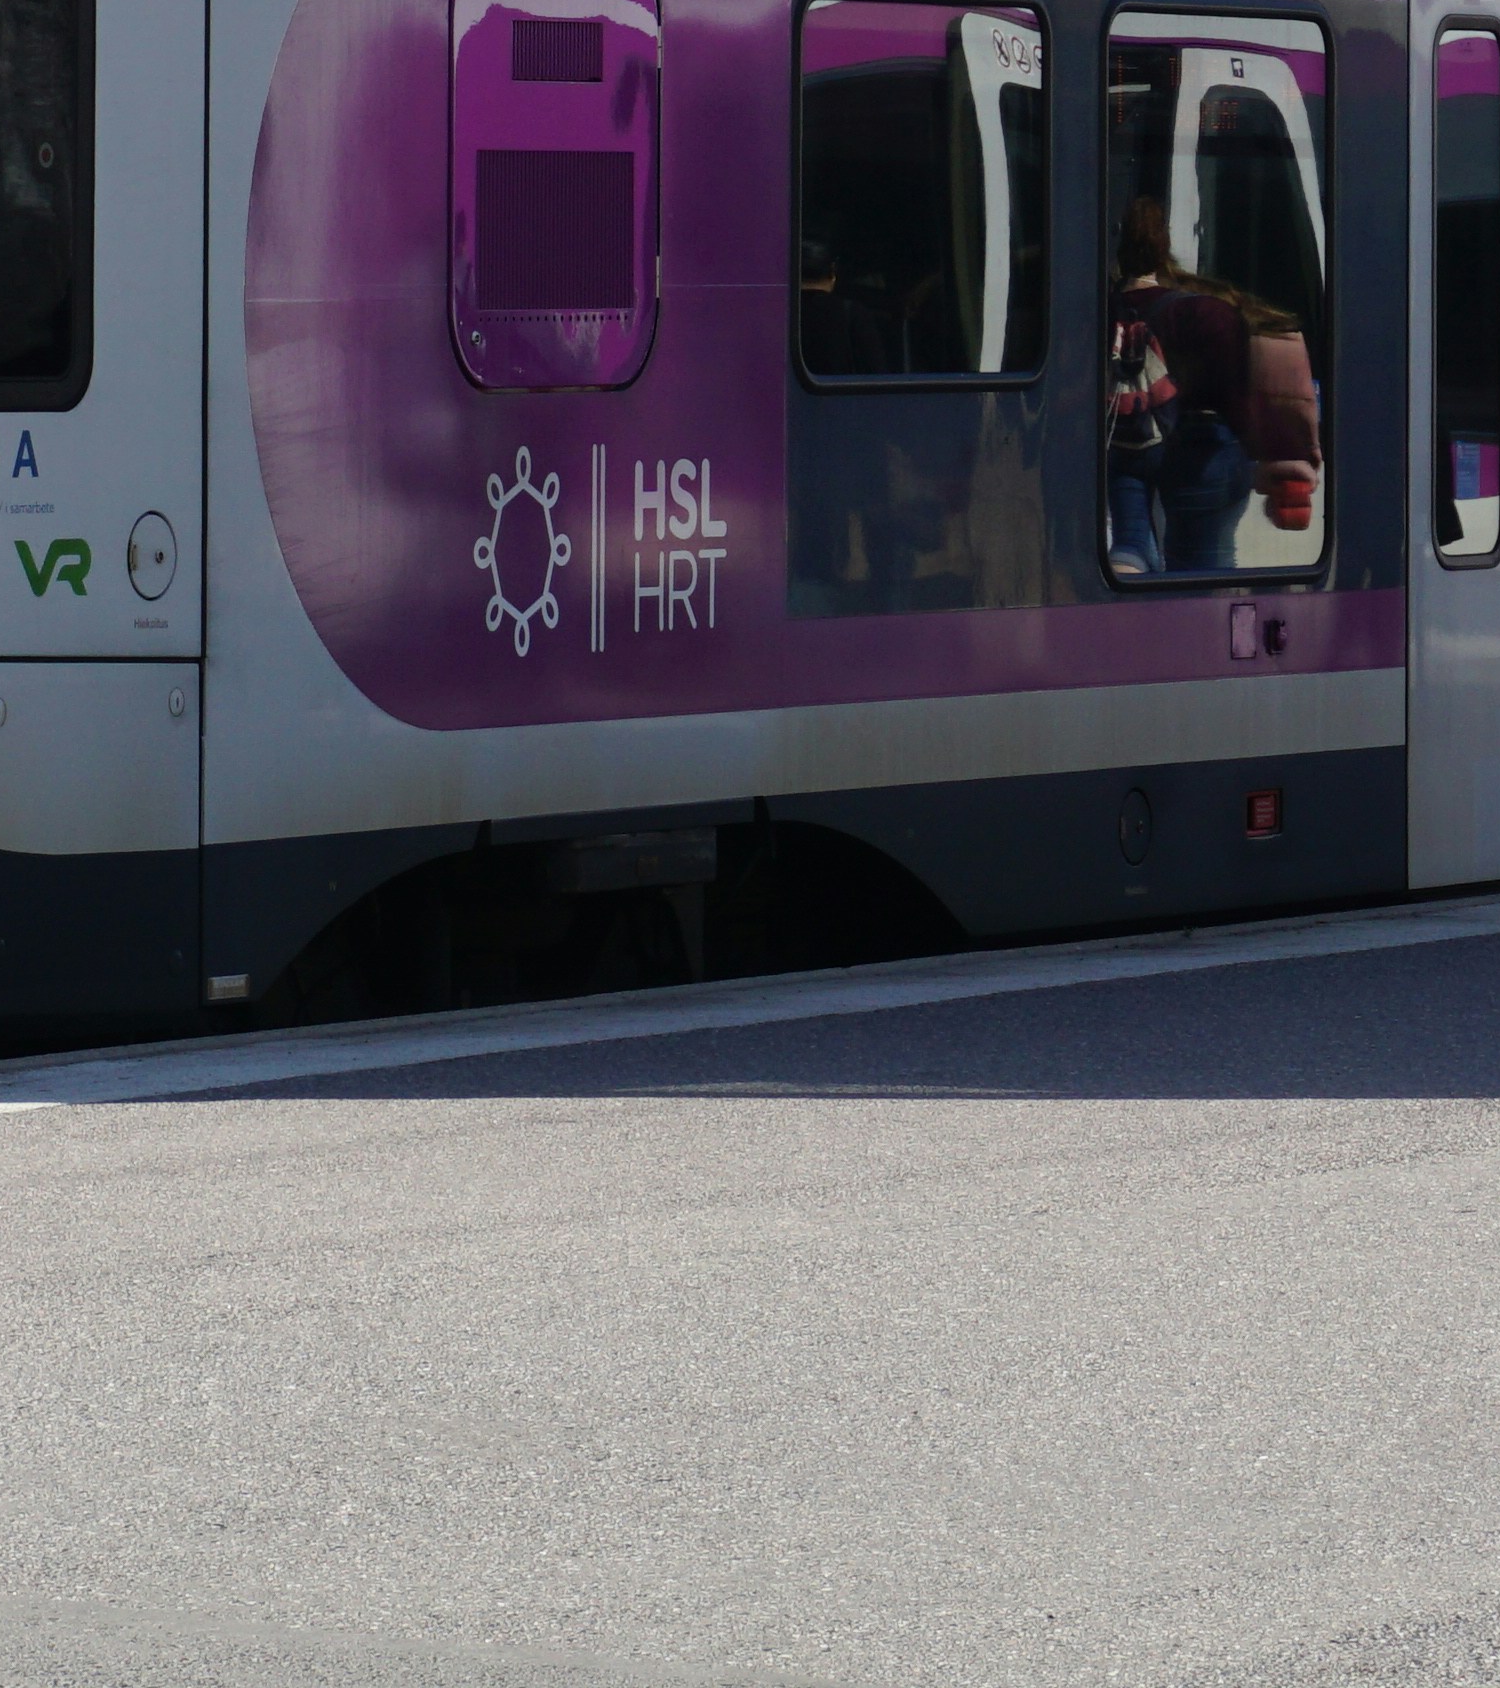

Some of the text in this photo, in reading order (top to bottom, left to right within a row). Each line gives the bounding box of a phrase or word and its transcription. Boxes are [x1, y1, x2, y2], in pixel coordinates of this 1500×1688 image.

[12, 430, 39, 478] A
[10, 501, 55, 514] samarbete
[634, 458, 727, 541] HSL
[14, 538, 92, 597] VR
[634, 548, 727, 632] HRT
